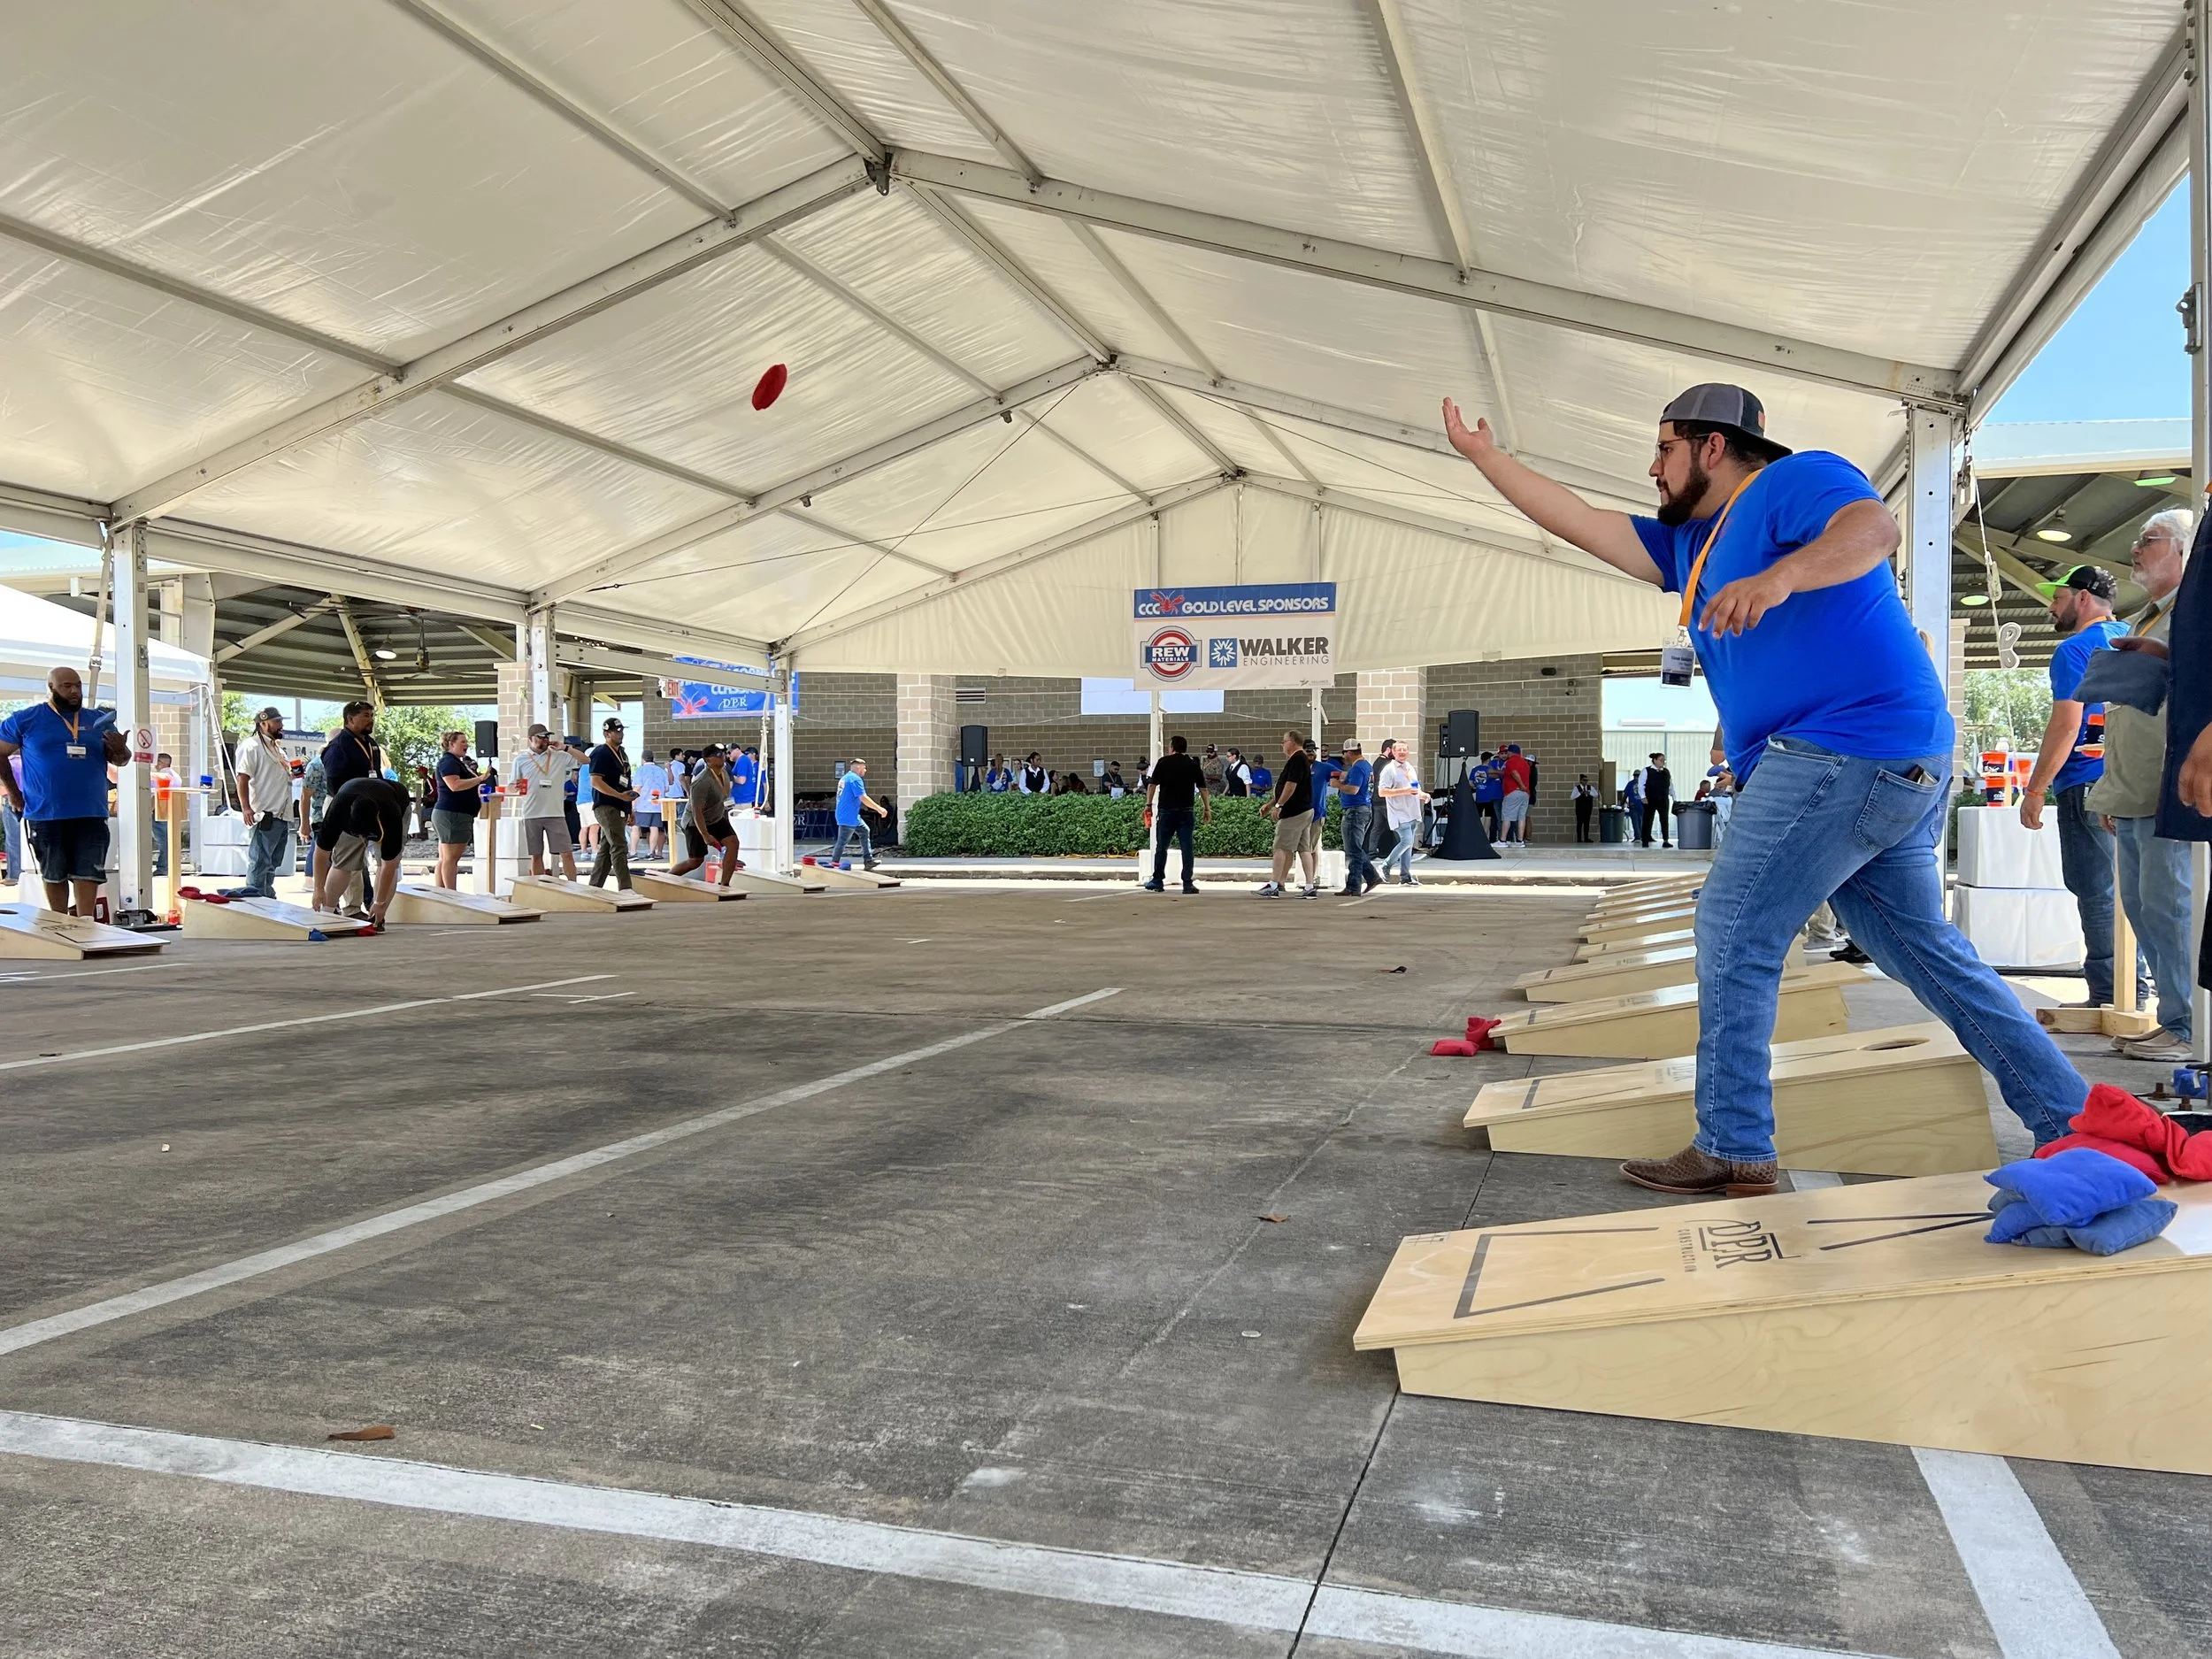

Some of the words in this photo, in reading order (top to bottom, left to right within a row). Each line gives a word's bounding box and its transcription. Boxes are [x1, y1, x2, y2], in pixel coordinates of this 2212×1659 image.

[1138, 603, 1160, 615] CCC
[1182, 601, 1219, 614] GOLD
[1220, 599, 1256, 612] LEVEL
[1258, 596, 1329, 611] SPONSORS
[1152, 647, 1190, 657] REW
[1239, 636, 1329, 656] WALKER
[1243, 655, 1329, 666] ENGINEERING
[667, 681, 679, 696] EXIT
[720, 695, 748, 708] DPR
[1678, 1228, 1697, 1272] CONSTRUCTION
[1704, 1220, 1774, 1269] DPR
